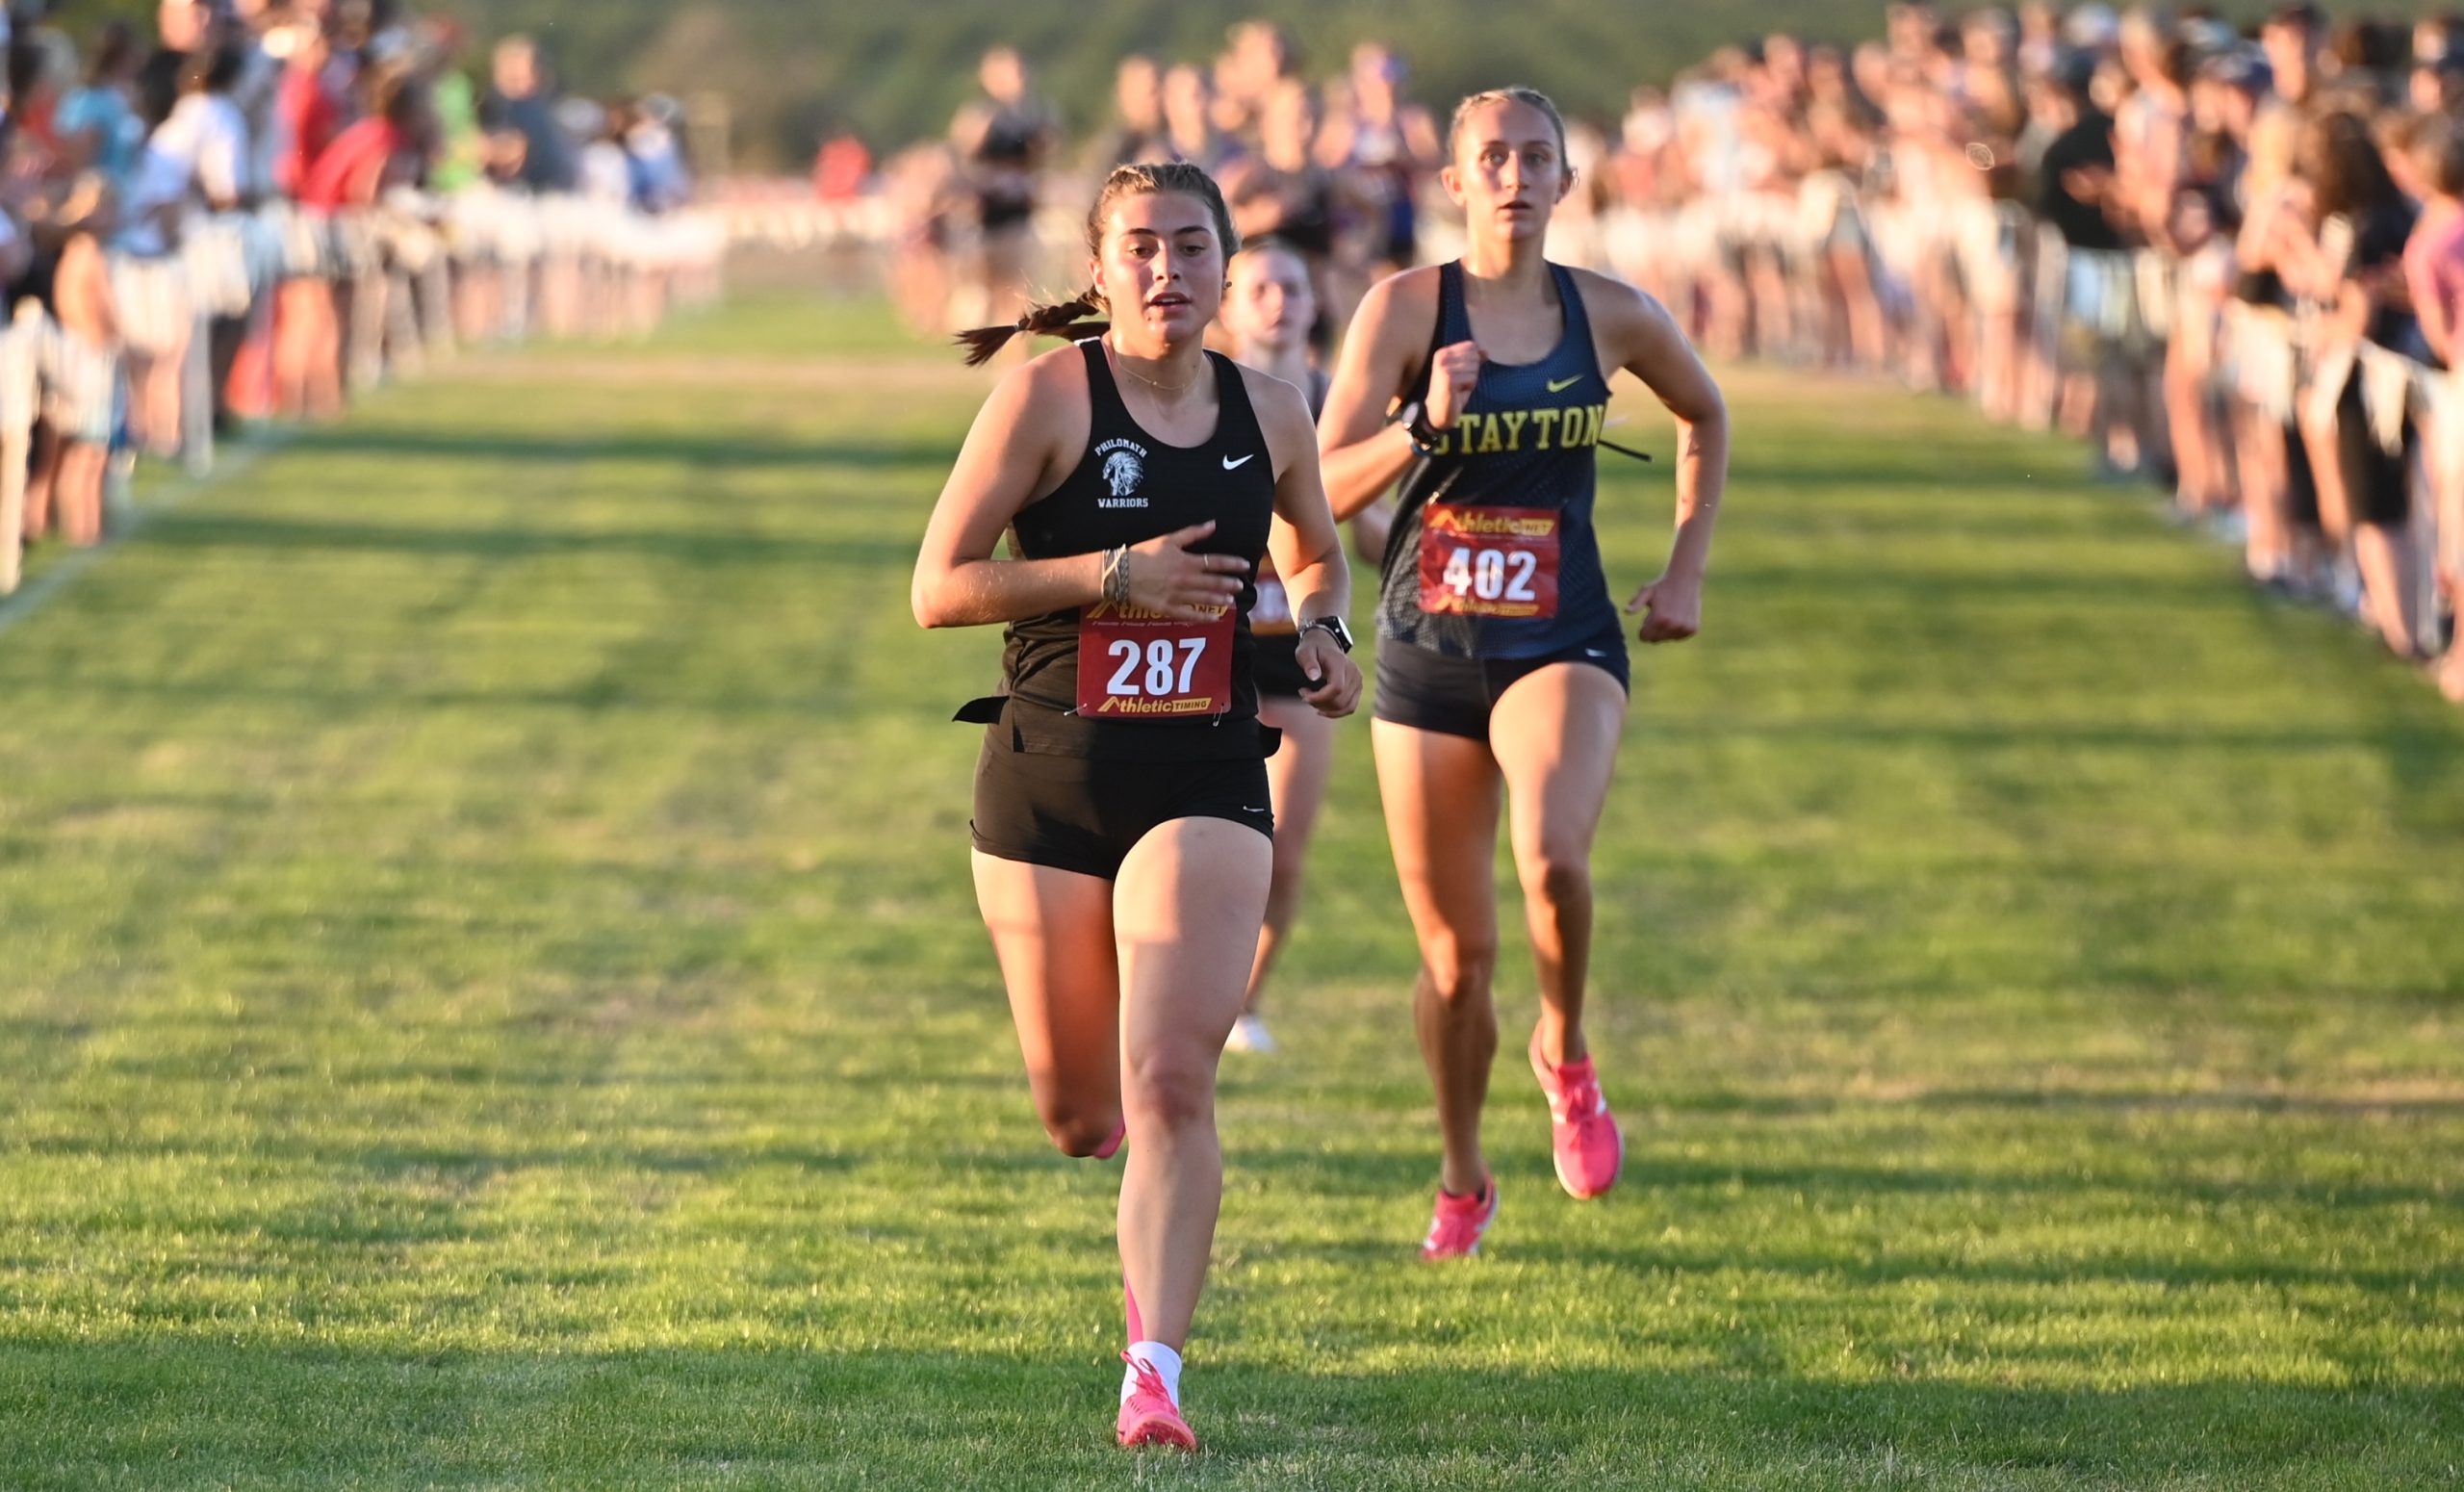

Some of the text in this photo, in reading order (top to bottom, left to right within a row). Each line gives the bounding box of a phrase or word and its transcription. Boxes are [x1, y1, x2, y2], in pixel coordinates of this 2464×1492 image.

[1094, 438, 1148, 458] PHILOMATH
[1097, 498, 1149, 508] WARRIORS
[1443, 547, 1537, 601] 402
[1107, 637, 1207, 696] 287
[1097, 696, 1208, 712] Athletic TIMING
